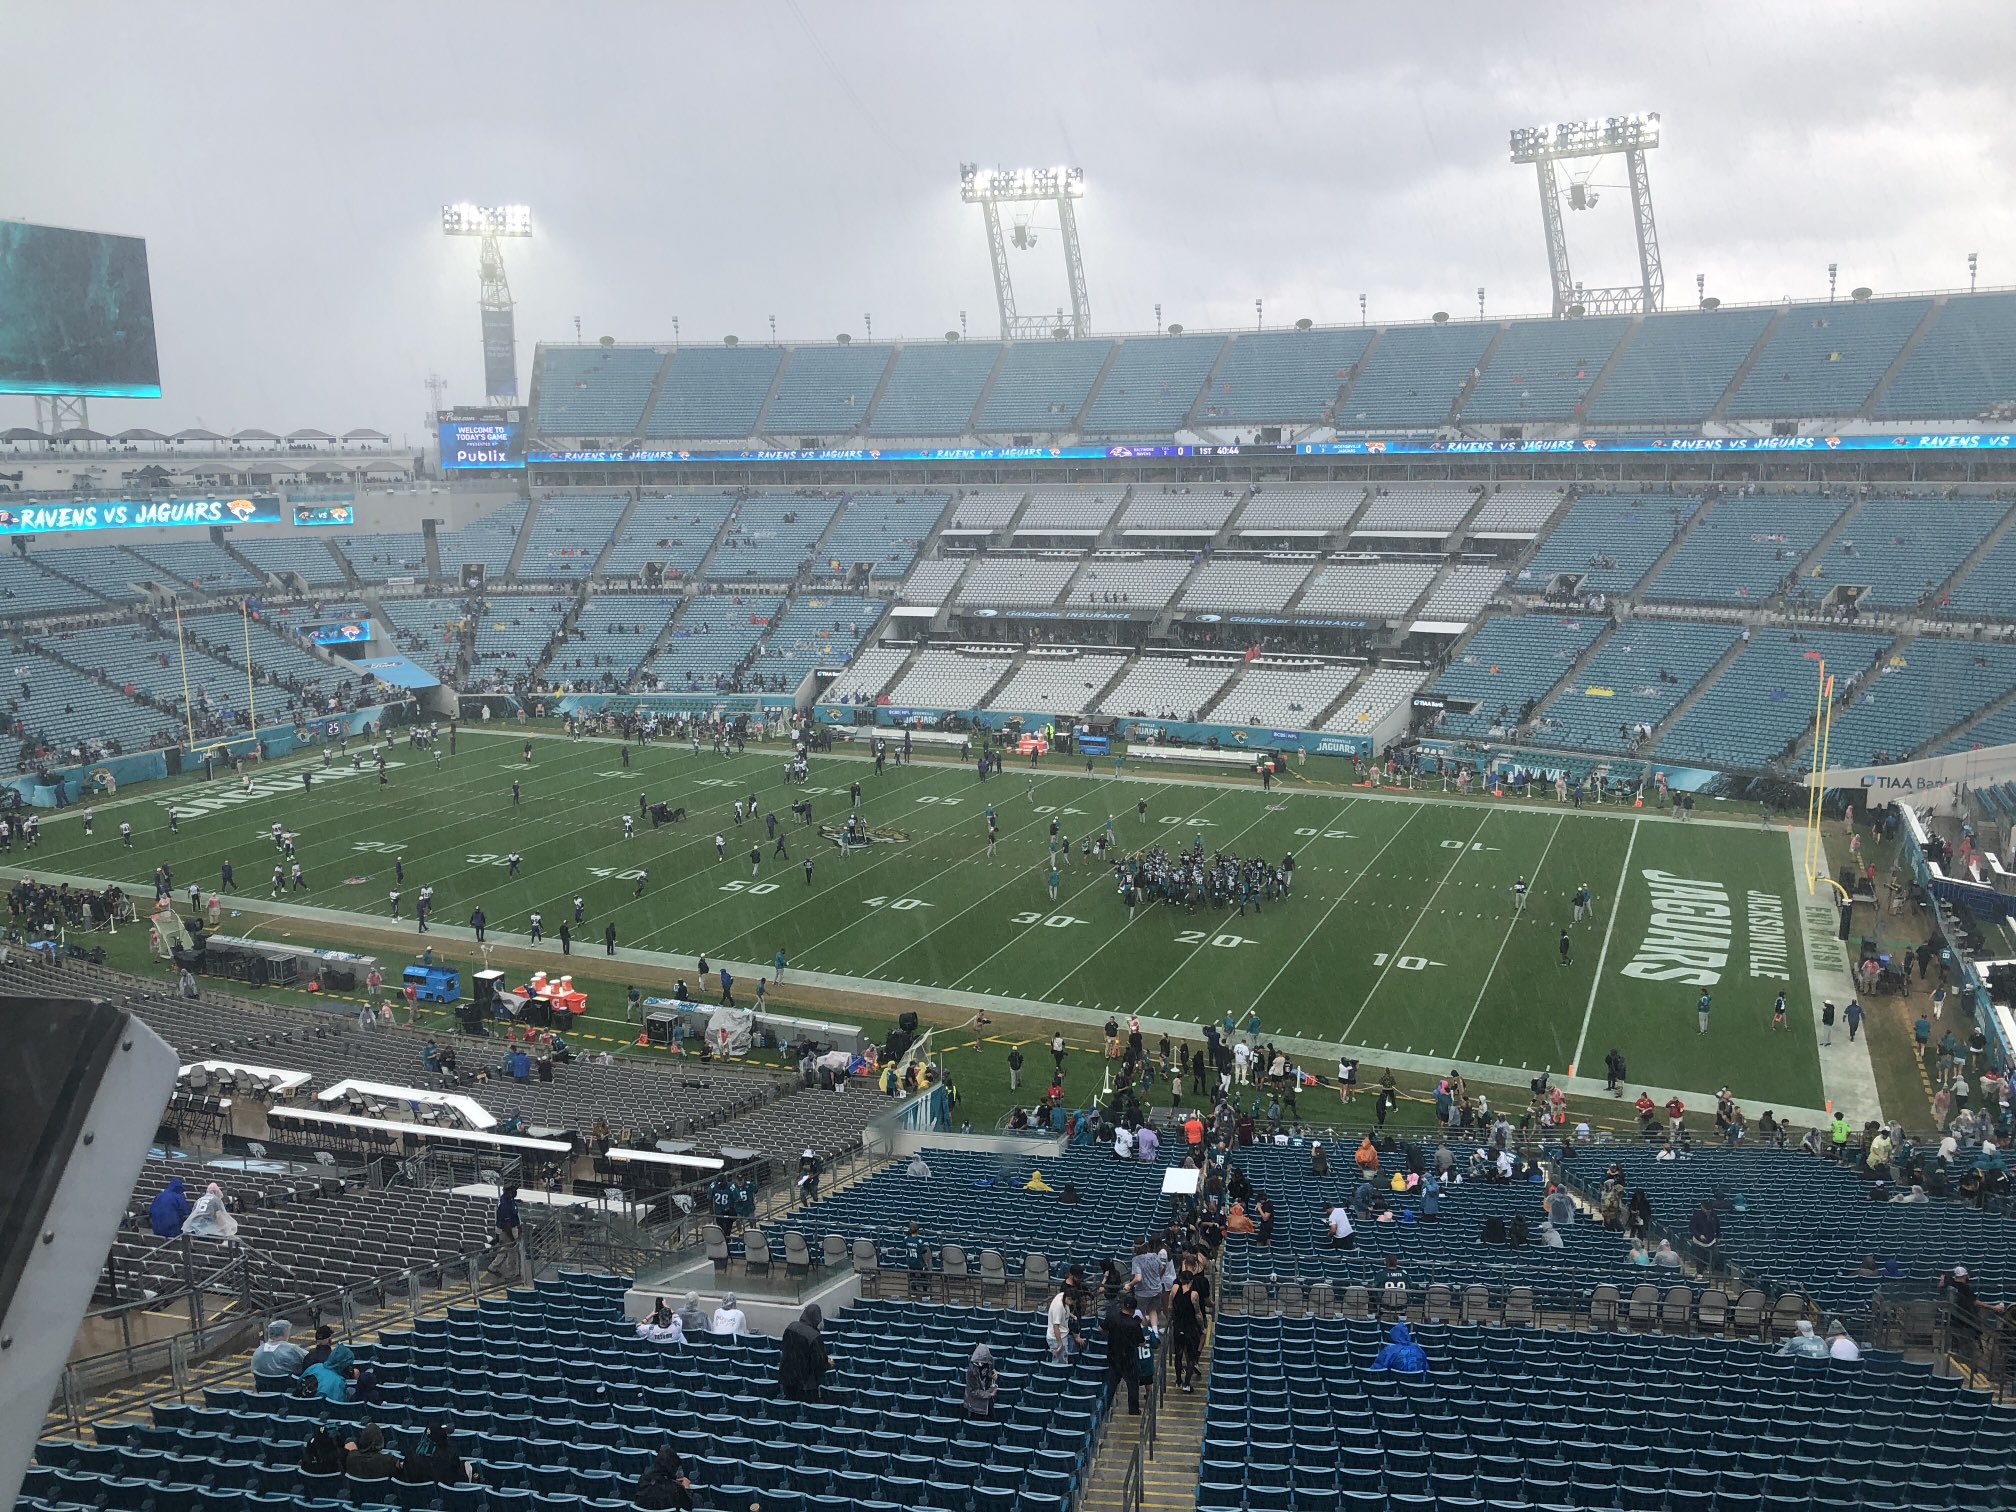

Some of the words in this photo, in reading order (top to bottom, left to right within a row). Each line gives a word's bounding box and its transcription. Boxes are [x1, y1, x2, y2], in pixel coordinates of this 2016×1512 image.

[458, 426, 493, 434] WELCOME
[495, 426, 505, 434] TO
[1447, 442, 1494, 451] RAVENS
[1500, 442, 1516, 450] VS
[1521, 440, 1575, 450] JAGUARS
[1671, 439, 1723, 449] RAVENS
[1729, 439, 1748, 449] VS
[1753, 437, 1815, 448] JAGUARS
[1920, 435, 1980, 448] RAVENS
[1989, 435, 2010, 446] VS
[757, 451, 797, 459] RAVENS
[801, 451, 815, 459] VS
[820, 450, 863, 459] JAGUARS
[936, 450, 976, 458] RAVENS
[998, 448, 1042, 457] JAGUARS
[1177, 447, 1184, 456] 0
[1200, 447, 1212, 455] 1ST
[1216, 446, 1240, 455] 40:44
[1305, 444, 1312, 454] 0
[457, 450, 506, 462] Publix
[564, 452, 606, 461] RAVENS
[628, 451, 674, 460] JAGUARS
[21, 506, 98, 529] RAVENS
[104, 506, 128, 524] VS
[135, 501, 222, 524] JAGUARS
[1005, 610, 1061, 618] Gallagher
[1066, 611, 1132, 619] INSURANCE
[1229, 616, 1291, 625] Gallagher
[1294, 618, 1367, 627] INSURANCE
[328, 722, 339, 734] 25
[1316, 742, 1356, 754] JAGUARS
[1877, 777, 1913, 789] TIAA
[719, 880, 781, 895] 50
[861, 896, 922, 910] 40
[1010, 911, 1076, 928] 30
[1805, 906, 1834, 927] END
[1620, 869, 1733, 986] JAGUARS
[1173, 930, 1244, 948] 20
[1747, 889, 1790, 981] JACKSONVILLE
[1372, 952, 1428, 971] 10
[580, 1000, 586, 1009] G
[1216, 1154, 1225, 1165] 16
[714, 1192, 729, 1206] 28
